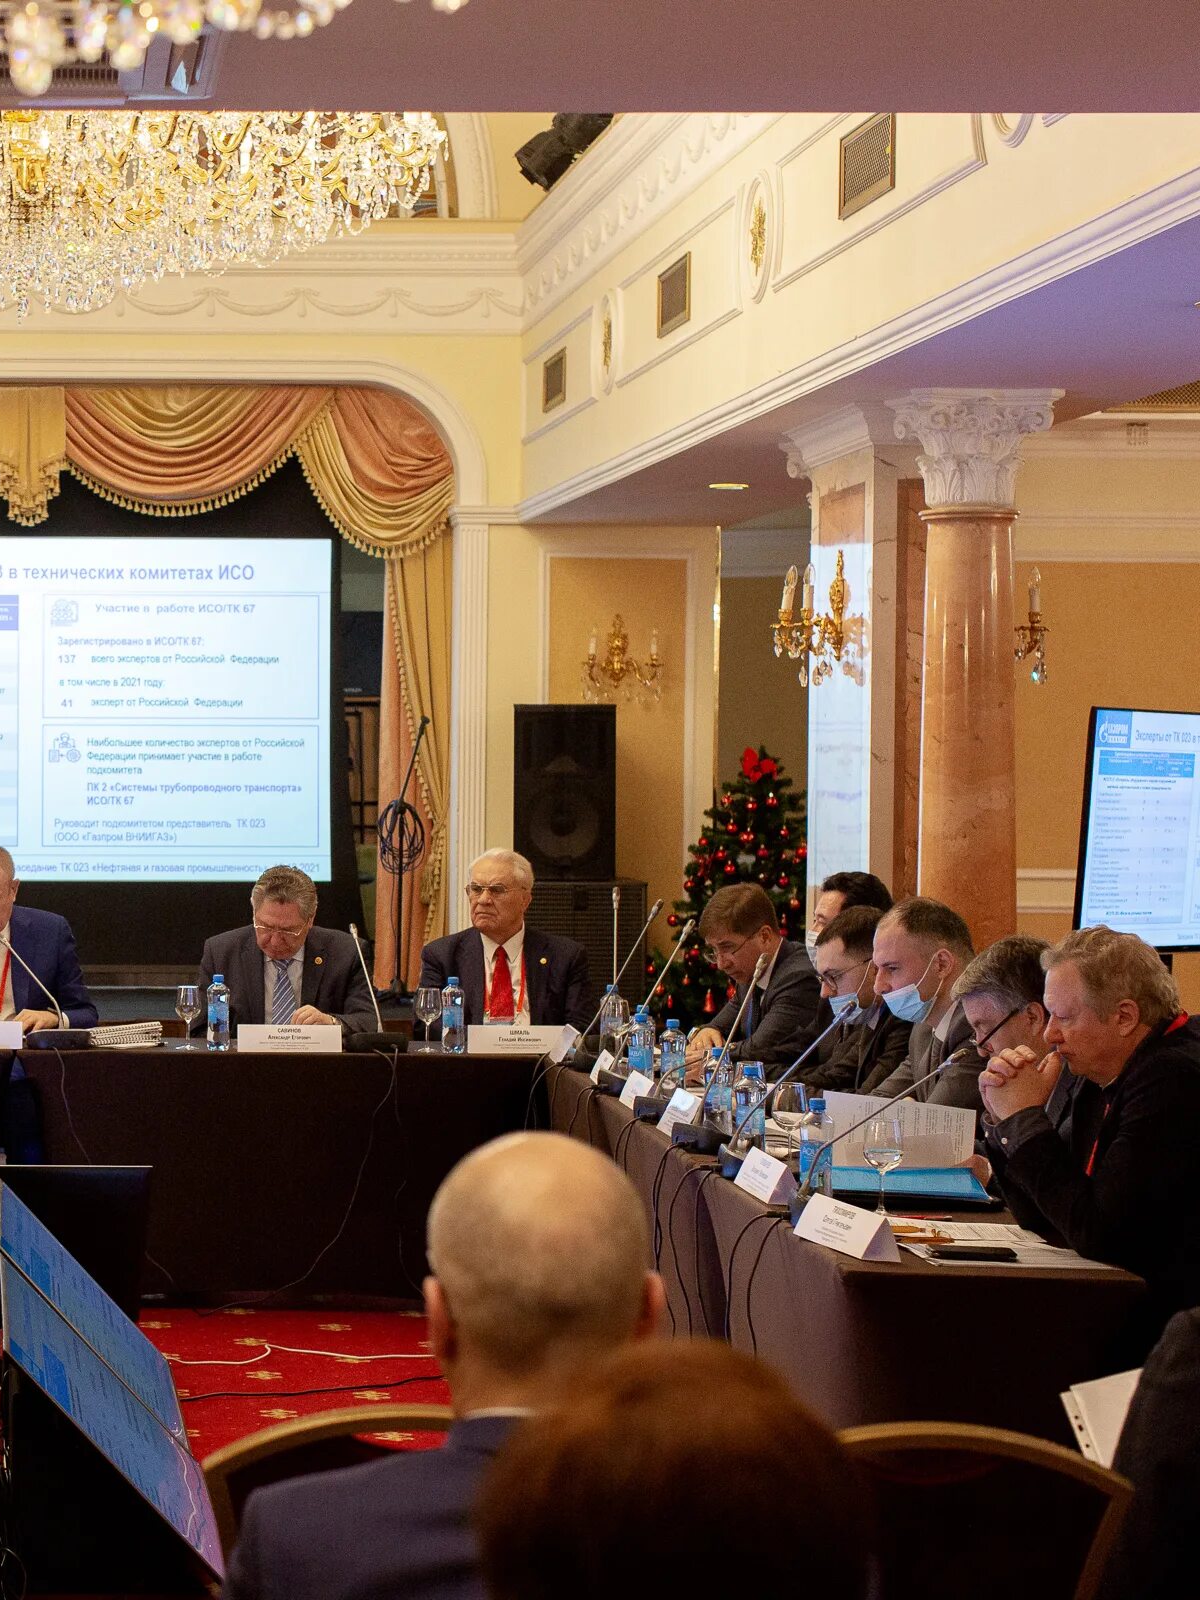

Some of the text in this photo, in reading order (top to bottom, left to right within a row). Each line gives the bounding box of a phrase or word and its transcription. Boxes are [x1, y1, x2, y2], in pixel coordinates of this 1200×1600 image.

[8, 568, 18, 579] в
[22, 568, 124, 580] технических
[130, 568, 214, 580] комитетах
[218, 564, 255, 581] ИСО
[95, 603, 256, 615] Участие в работе ИСО/ТК 67
[58, 636, 204, 648] Зарегистрировано в ИСО/ТК 67:
[58, 653, 280, 665] 137 всего экспертов от Российской Федерации
[58, 676, 164, 689] в том числе в 2021 году:
[60, 696, 244, 708] 41 эксперт от Российской Федерации
[86, 737, 305, 749] Наибольшее количество экспертов от Российской
[86, 751, 262, 762] Федерации принимает участие в работе
[86, 766, 143, 776] подкомитета
[87, 782, 302, 794] ПК 2 «Системы трубопроводного транспорта»
[86, 796, 135, 806] ИСО/ТК 67
[54, 818, 266, 830] Руководит подкомитетом представитель ТК 023
[16, 863, 58, 873] аседание
[60, 862, 72, 873] ТК
[73, 862, 90, 873] 023
[92, 862, 142, 874] «Нефтяная
[143, 864, 149, 872] и
[151, 864, 186, 873] газовая
